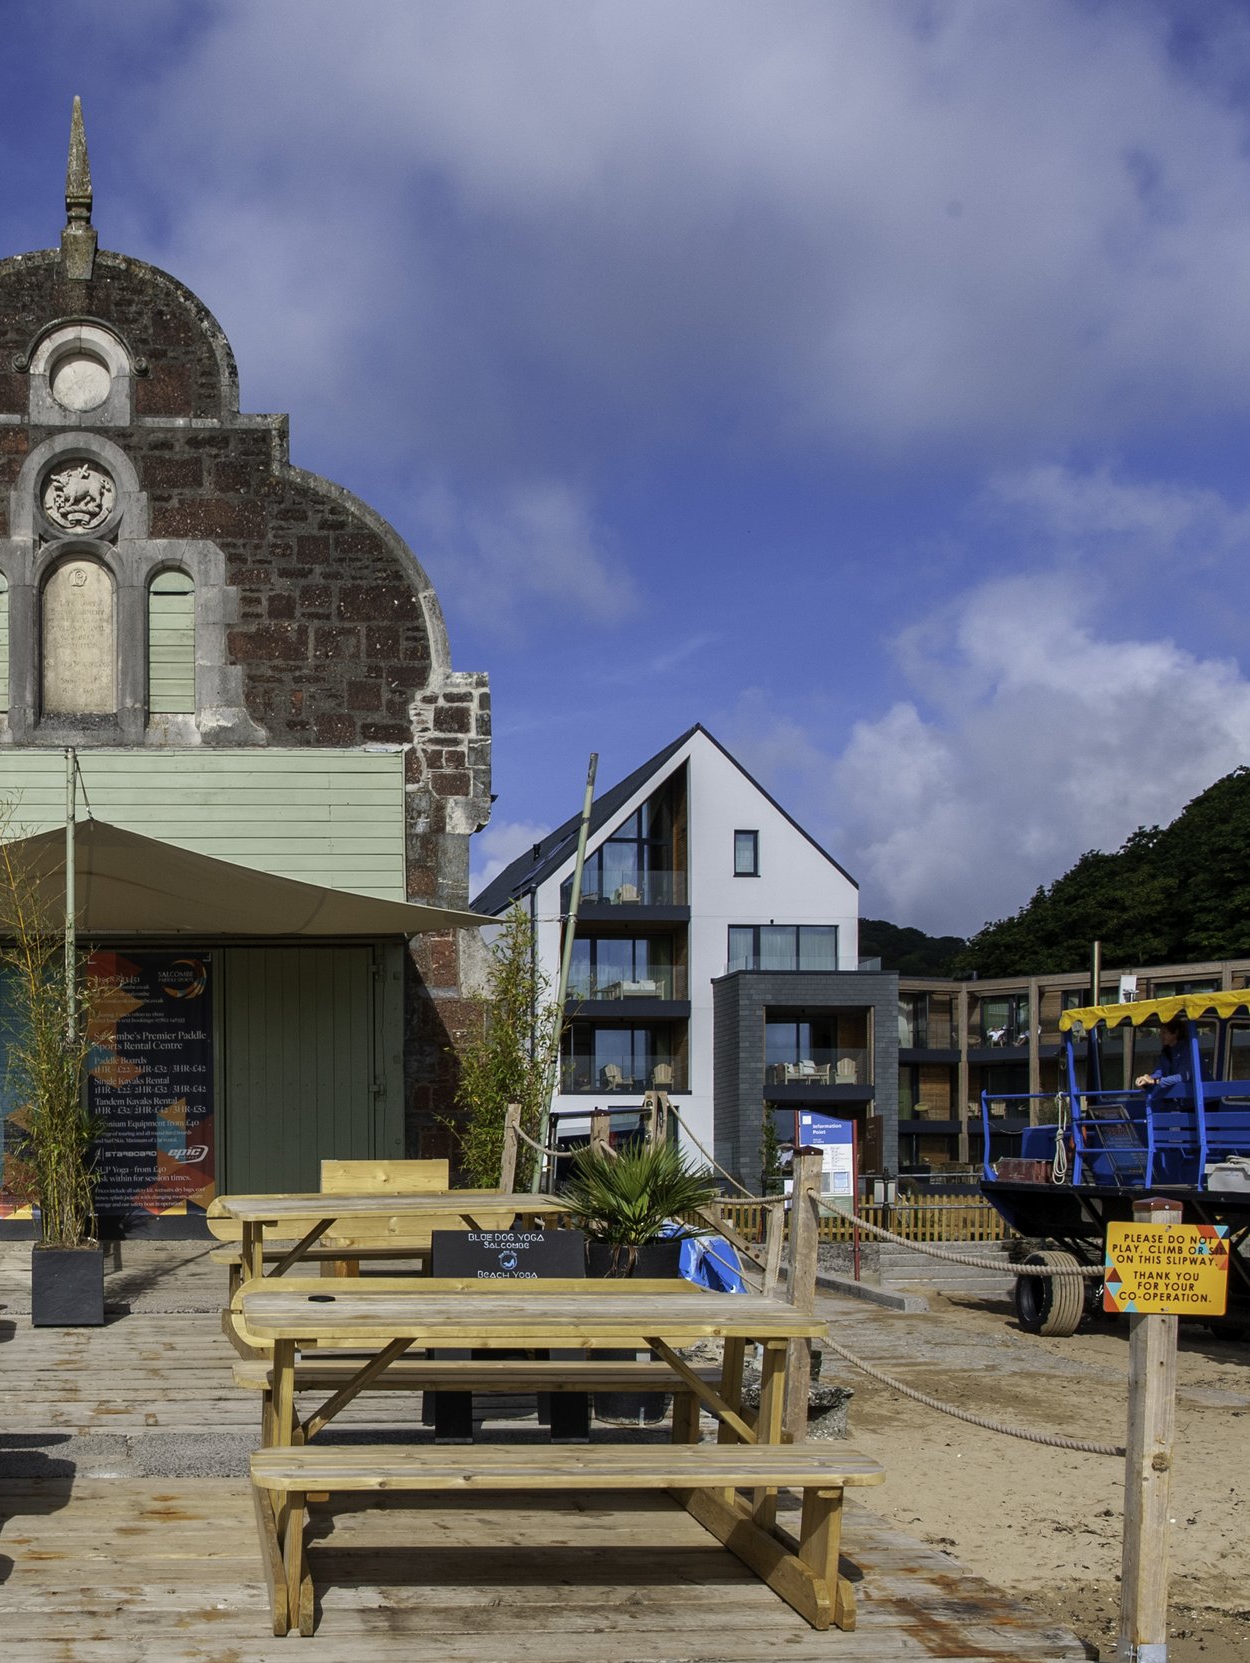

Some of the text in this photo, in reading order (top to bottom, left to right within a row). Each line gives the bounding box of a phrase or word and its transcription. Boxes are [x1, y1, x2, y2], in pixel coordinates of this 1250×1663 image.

[94, 1031, 207, 1040] Smbe's Premier Paddle
[124, 1041, 151, 1050] Rental
[153, 1041, 183, 1050] Centre
[94, 1057, 119, 1065] Paddle
[94, 1076, 170, 1086] Single Kayaks Rental
[172, 1085, 207, 1093] 3HR-£42
[94, 1097, 178, 1107] Tandem Kayaks Rental
[173, 1105, 207, 1113] 3HR-£52
[127, 1120, 166, 1129] Equipment
[167, 1119, 184, 1127] from
[186, 1120, 200, 1128] £40
[113, 1167, 129, 1175] Yoga
[153, 1166, 166, 1174] £40
[468, 1233, 545, 1241] BLUE DOG YOGA
[1124, 1234, 1214, 1245] PLEASE DO NOT
[1112, 1244, 1225, 1255] PLAY, CLIMB OR SIT
[1116, 1255, 1218, 1266] ON THIS SLIPWAY.
[1134, 1271, 1199, 1281] THANK YOU
[1138, 1282, 1195, 1291] FOR YOUR
[1119, 1292, 1212, 1303] CO-OPERATION.
